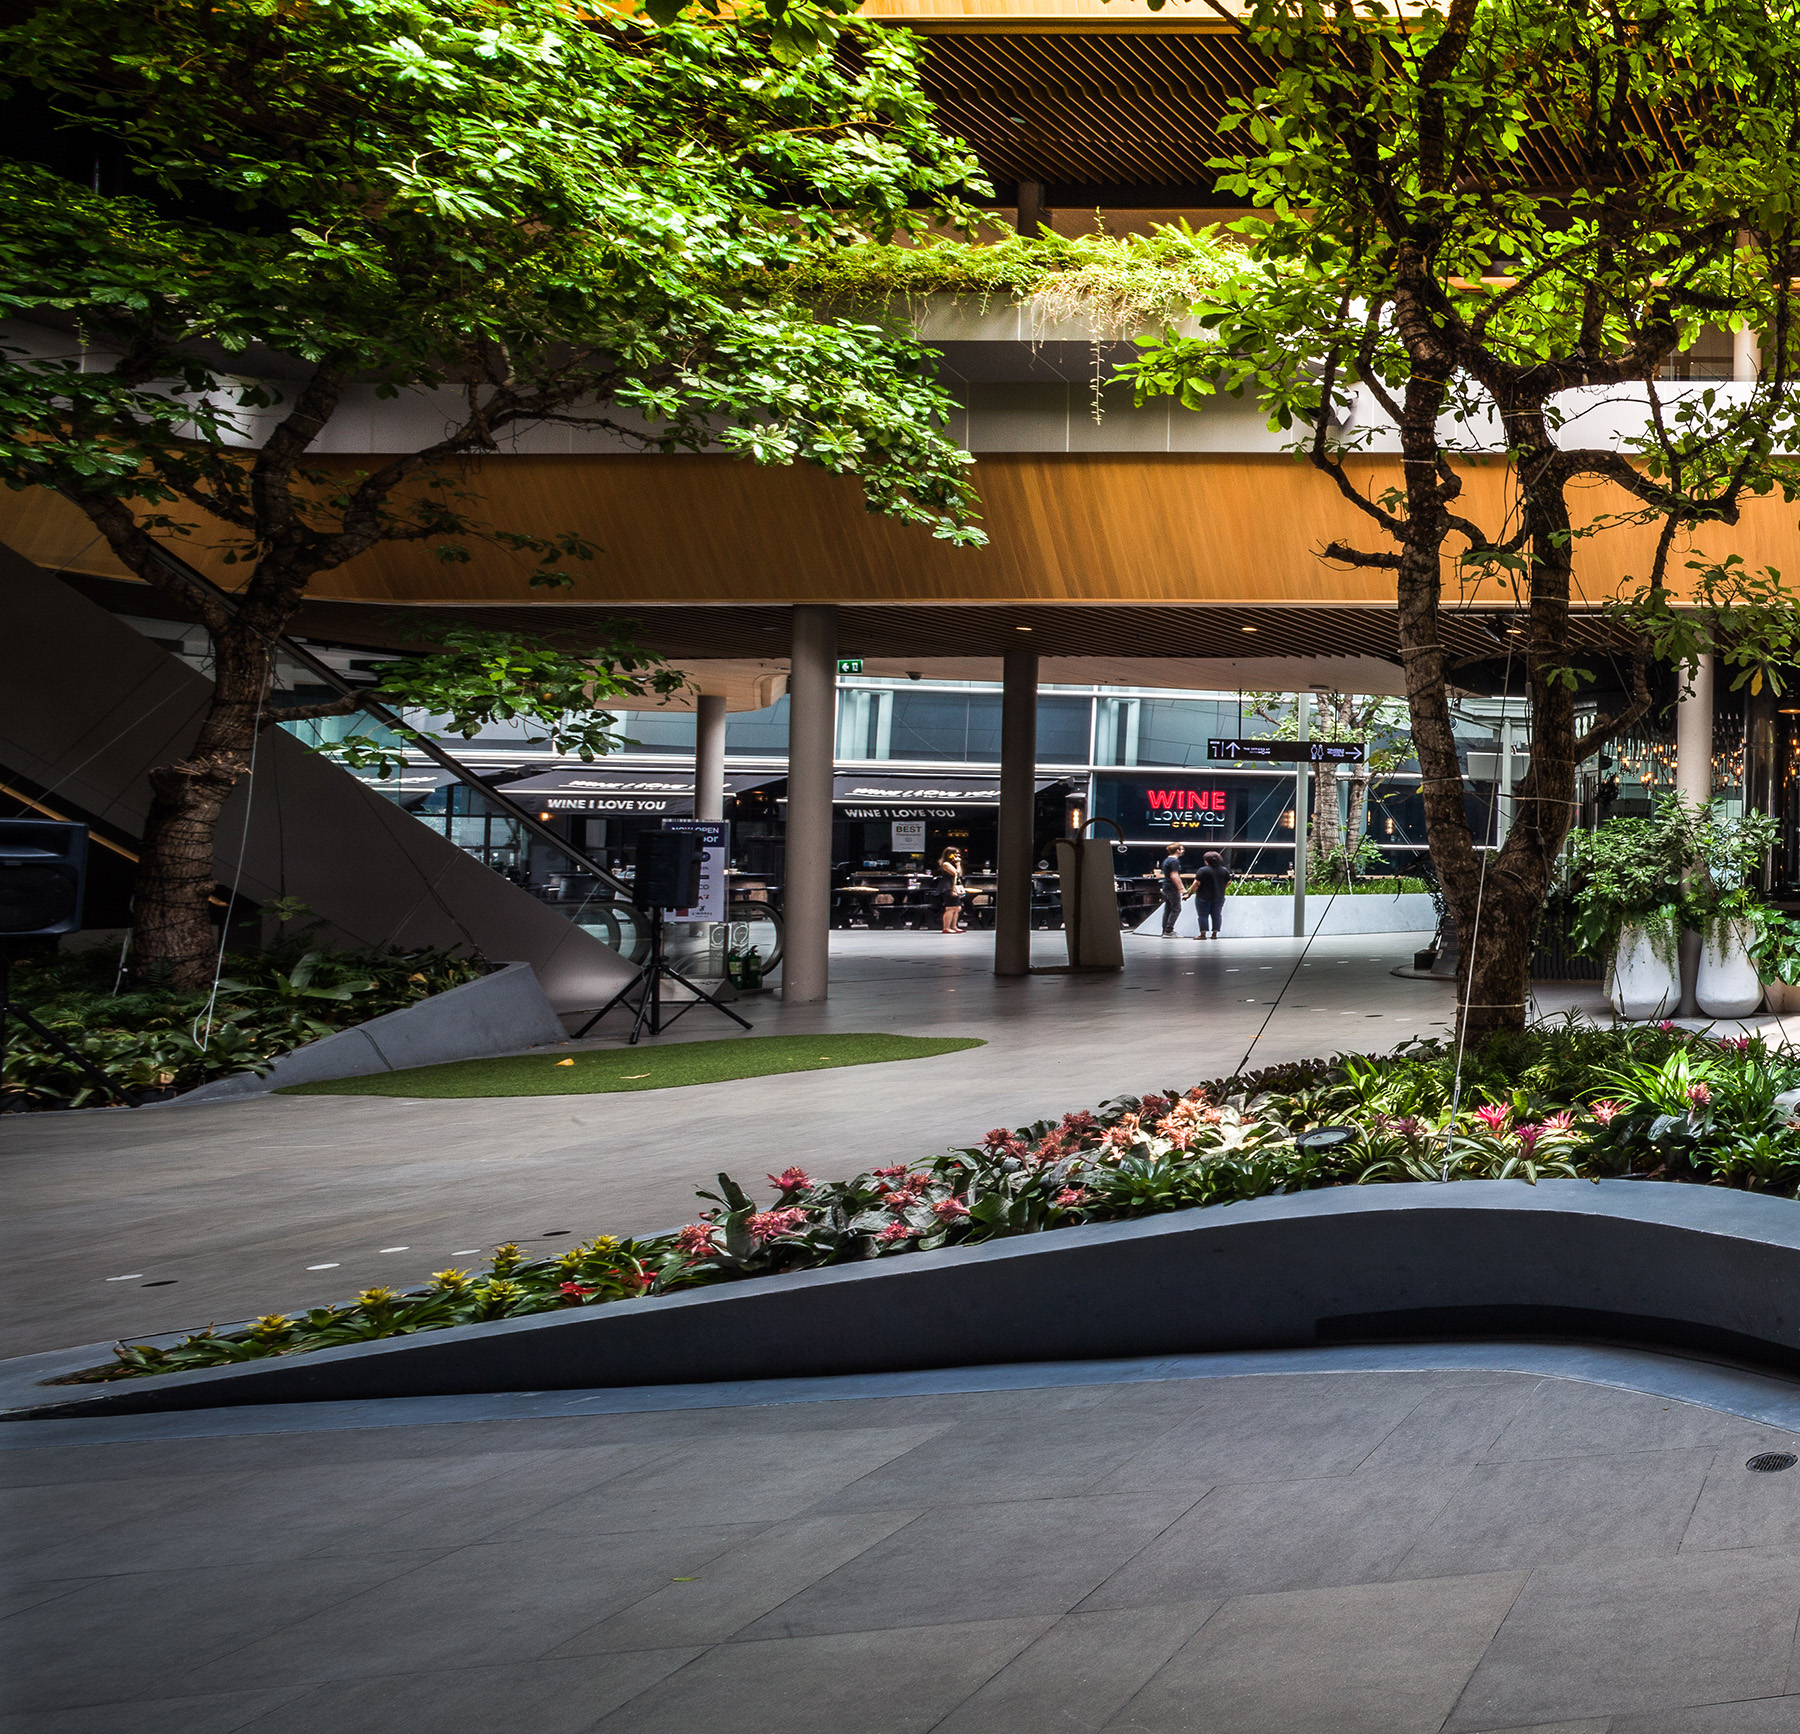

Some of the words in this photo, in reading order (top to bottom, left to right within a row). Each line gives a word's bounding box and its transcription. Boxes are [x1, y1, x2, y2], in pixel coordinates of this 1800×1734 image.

[547, 799, 586, 809] WINE
[588, 800, 595, 809] I
[598, 799, 634, 810] LOVE
[637, 801, 667, 811] YOU
[1147, 789, 1226, 811] WINE
[845, 809, 882, 818] WINE
[884, 809, 889, 818] I
[891, 809, 927, 818] LOVE
[927, 809, 956, 818] YOU
[1152, 810, 1193, 821] LOVE
[1195, 811, 1225, 822] YOU
[896, 825, 922, 833] BEST
